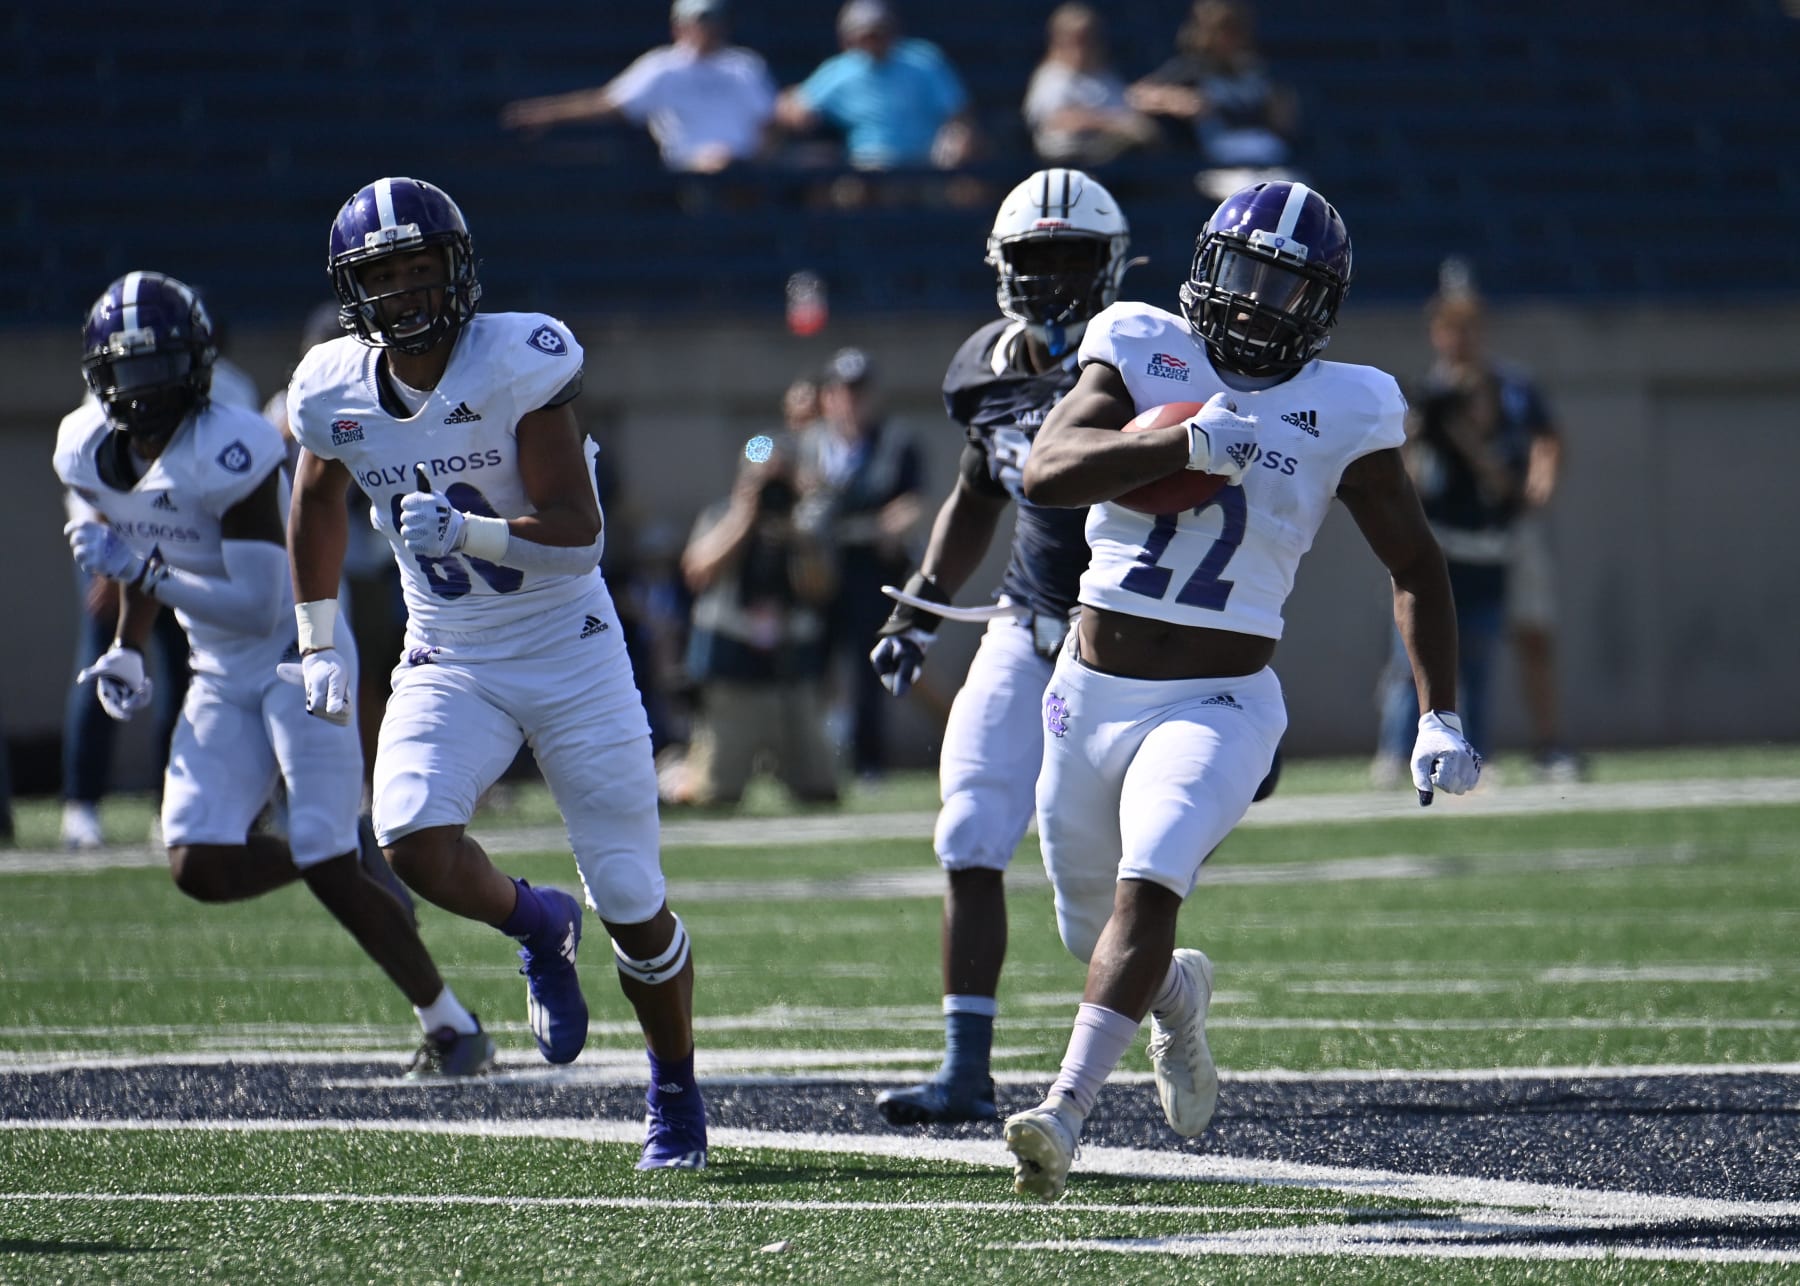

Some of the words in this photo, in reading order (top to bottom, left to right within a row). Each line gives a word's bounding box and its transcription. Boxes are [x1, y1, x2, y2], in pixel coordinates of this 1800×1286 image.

[1147, 363, 1190, 376] PATRIOT
[1147, 369, 1189, 382] LEAGUE
[444, 413, 482, 425] adidas
[1281, 414, 1320, 438] adidas
[356, 464, 406, 488] HOLY
[580, 622, 609, 639] adidas
[1201, 700, 1243, 710] adidas
